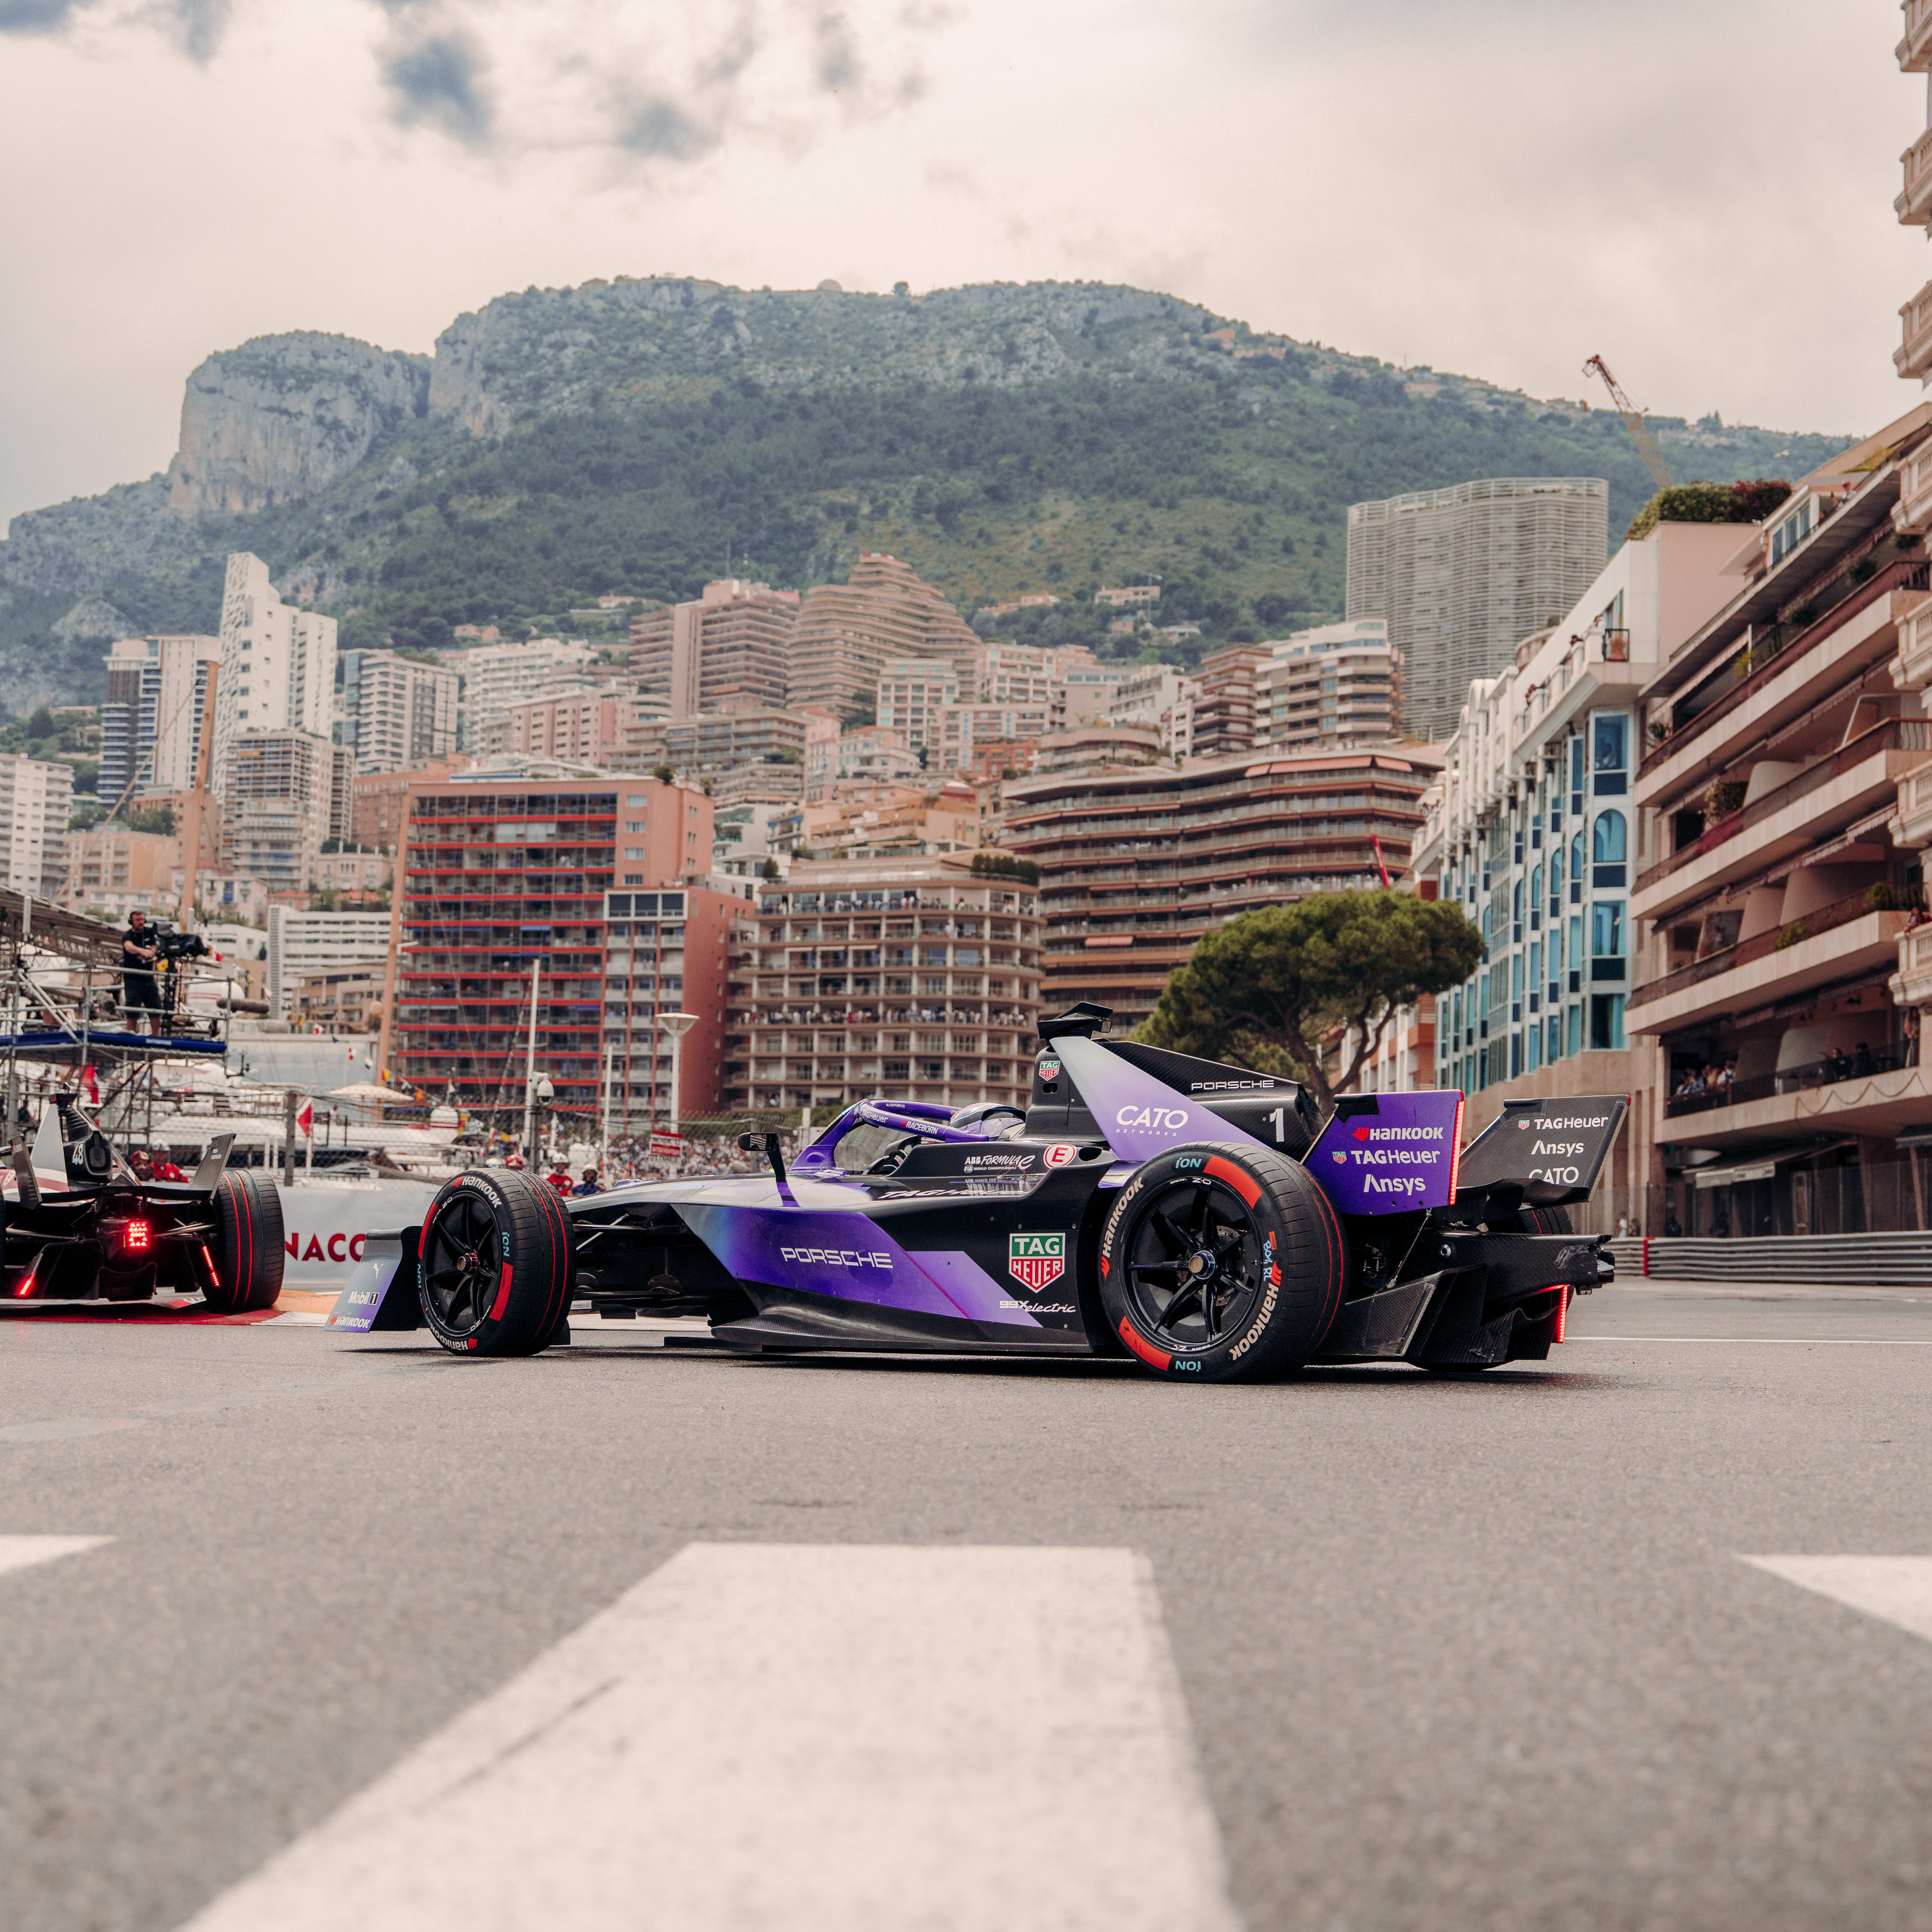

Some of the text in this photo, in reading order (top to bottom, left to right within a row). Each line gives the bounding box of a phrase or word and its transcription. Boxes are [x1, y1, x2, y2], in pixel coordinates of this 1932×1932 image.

[1040, 1069, 1057, 1079] HEUER
[1191, 1080, 1274, 1090] PORSCHE
[1117, 1105, 1189, 1129] CATO
[1270, 1108, 1284, 1142] 1
[906, 1121, 938, 1135] RACEBORN
[1116, 1128, 1177, 1136] NETWORKS
[72, 1143, 84, 1165] 48
[1051, 1147, 1068, 1163] E
[1531, 1140, 1584, 1157] Ansys
[965, 1156, 981, 1165] ABB
[980, 1155, 1022, 1165] FORMULA
[1529, 1166, 1579, 1184] CATO
[1364, 1174, 1426, 1196] Ansys
[1015, 1237, 1060, 1255] TAG
[781, 1248, 893, 1269] PORSCHE
[1013, 1261, 1061, 1288] HEUER
[348, 1291, 370, 1305] Mobil
[999, 1300, 1076, 1312] 99X electric
